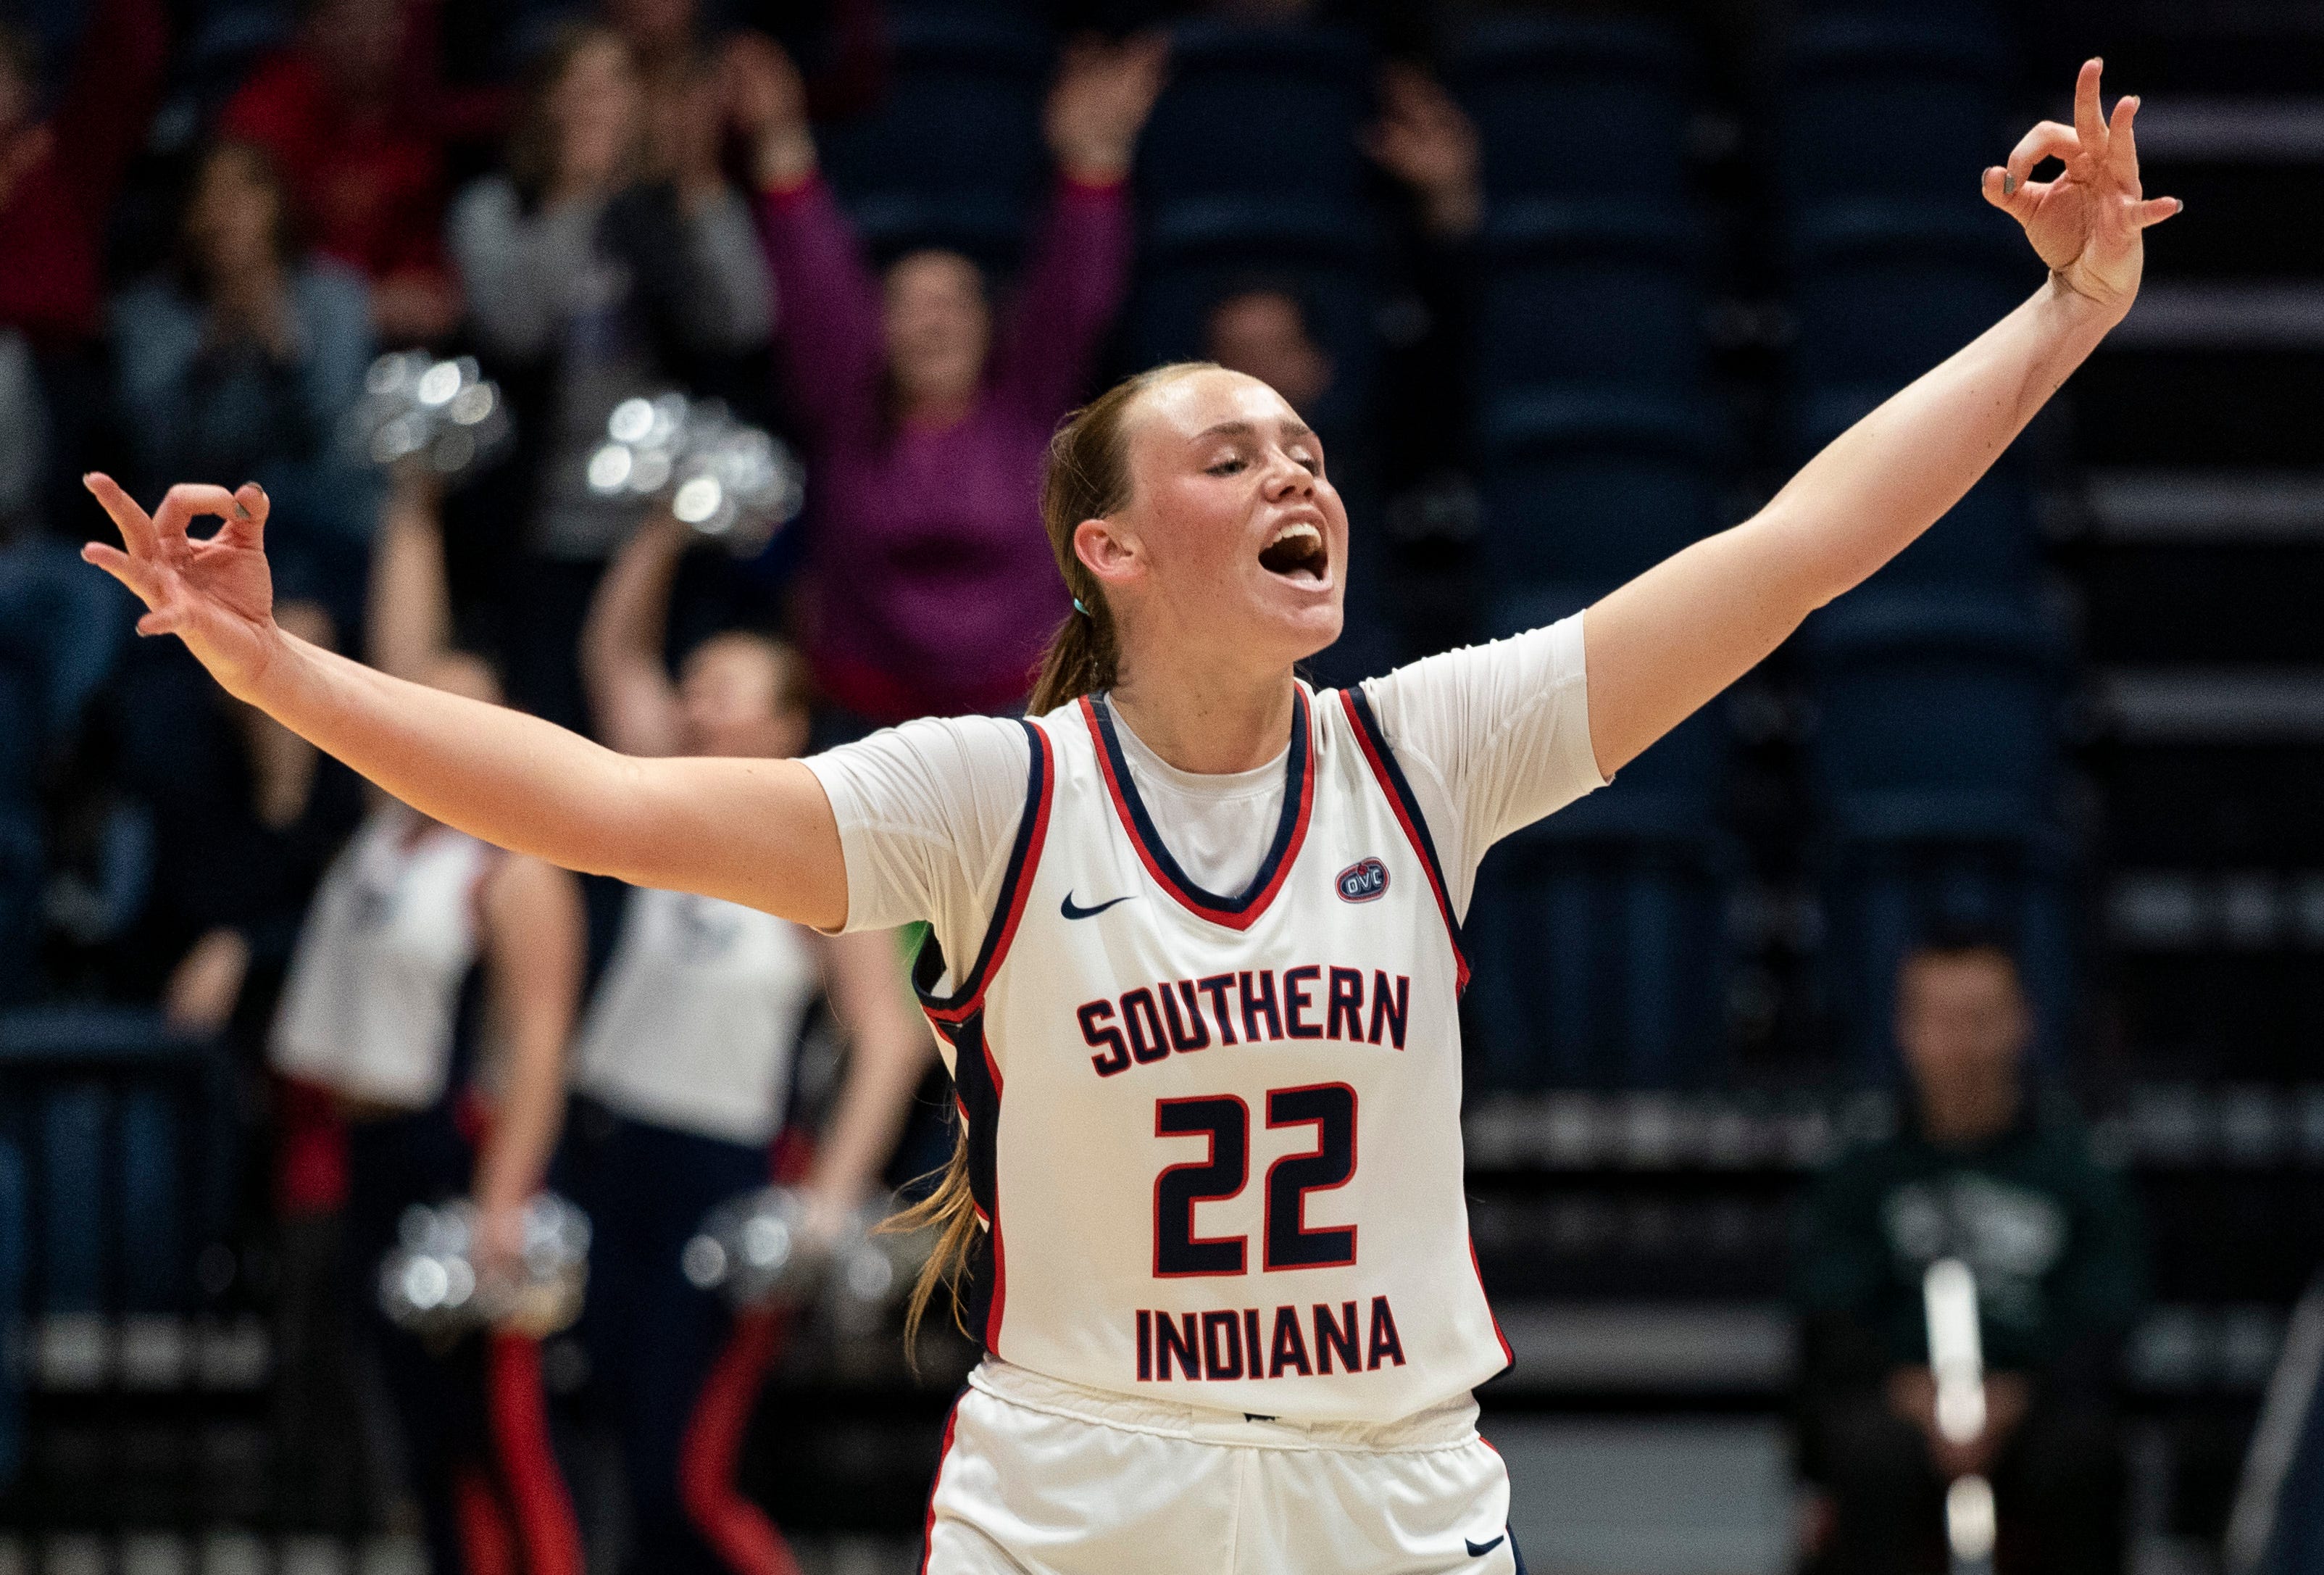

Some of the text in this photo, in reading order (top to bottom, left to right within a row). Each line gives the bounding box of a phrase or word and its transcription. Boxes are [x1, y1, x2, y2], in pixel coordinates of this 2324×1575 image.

[1347, 868, 1381, 894] OVC
[1077, 965, 1410, 1078] SOUTHERN
[1152, 1081, 1359, 1279] 22
[1136, 1295, 1407, 1382] INDIANA
